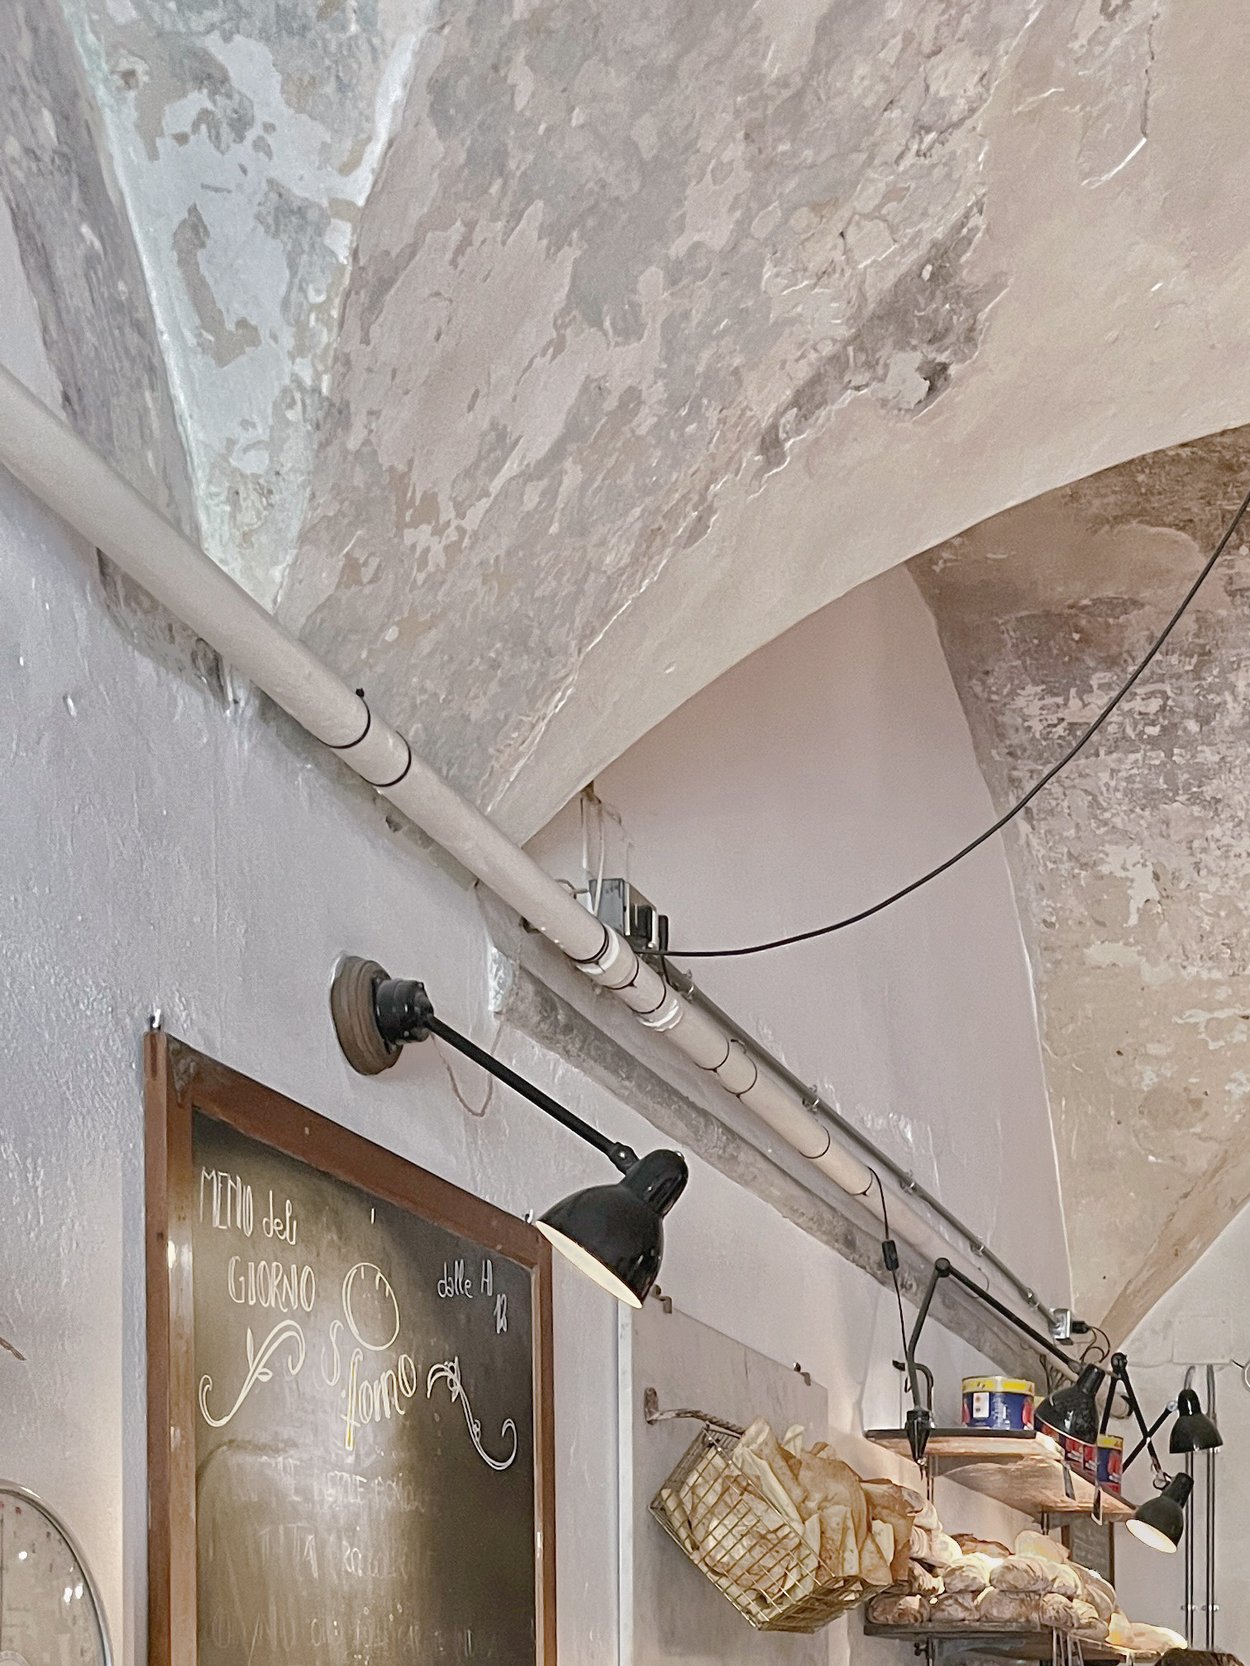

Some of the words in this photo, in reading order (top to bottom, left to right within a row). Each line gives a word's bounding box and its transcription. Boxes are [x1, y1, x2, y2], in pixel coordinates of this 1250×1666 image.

[262, 1189, 297, 1246] del
[227, 1255, 316, 1312] GIORNO
[437, 1259, 474, 1298] dalle
